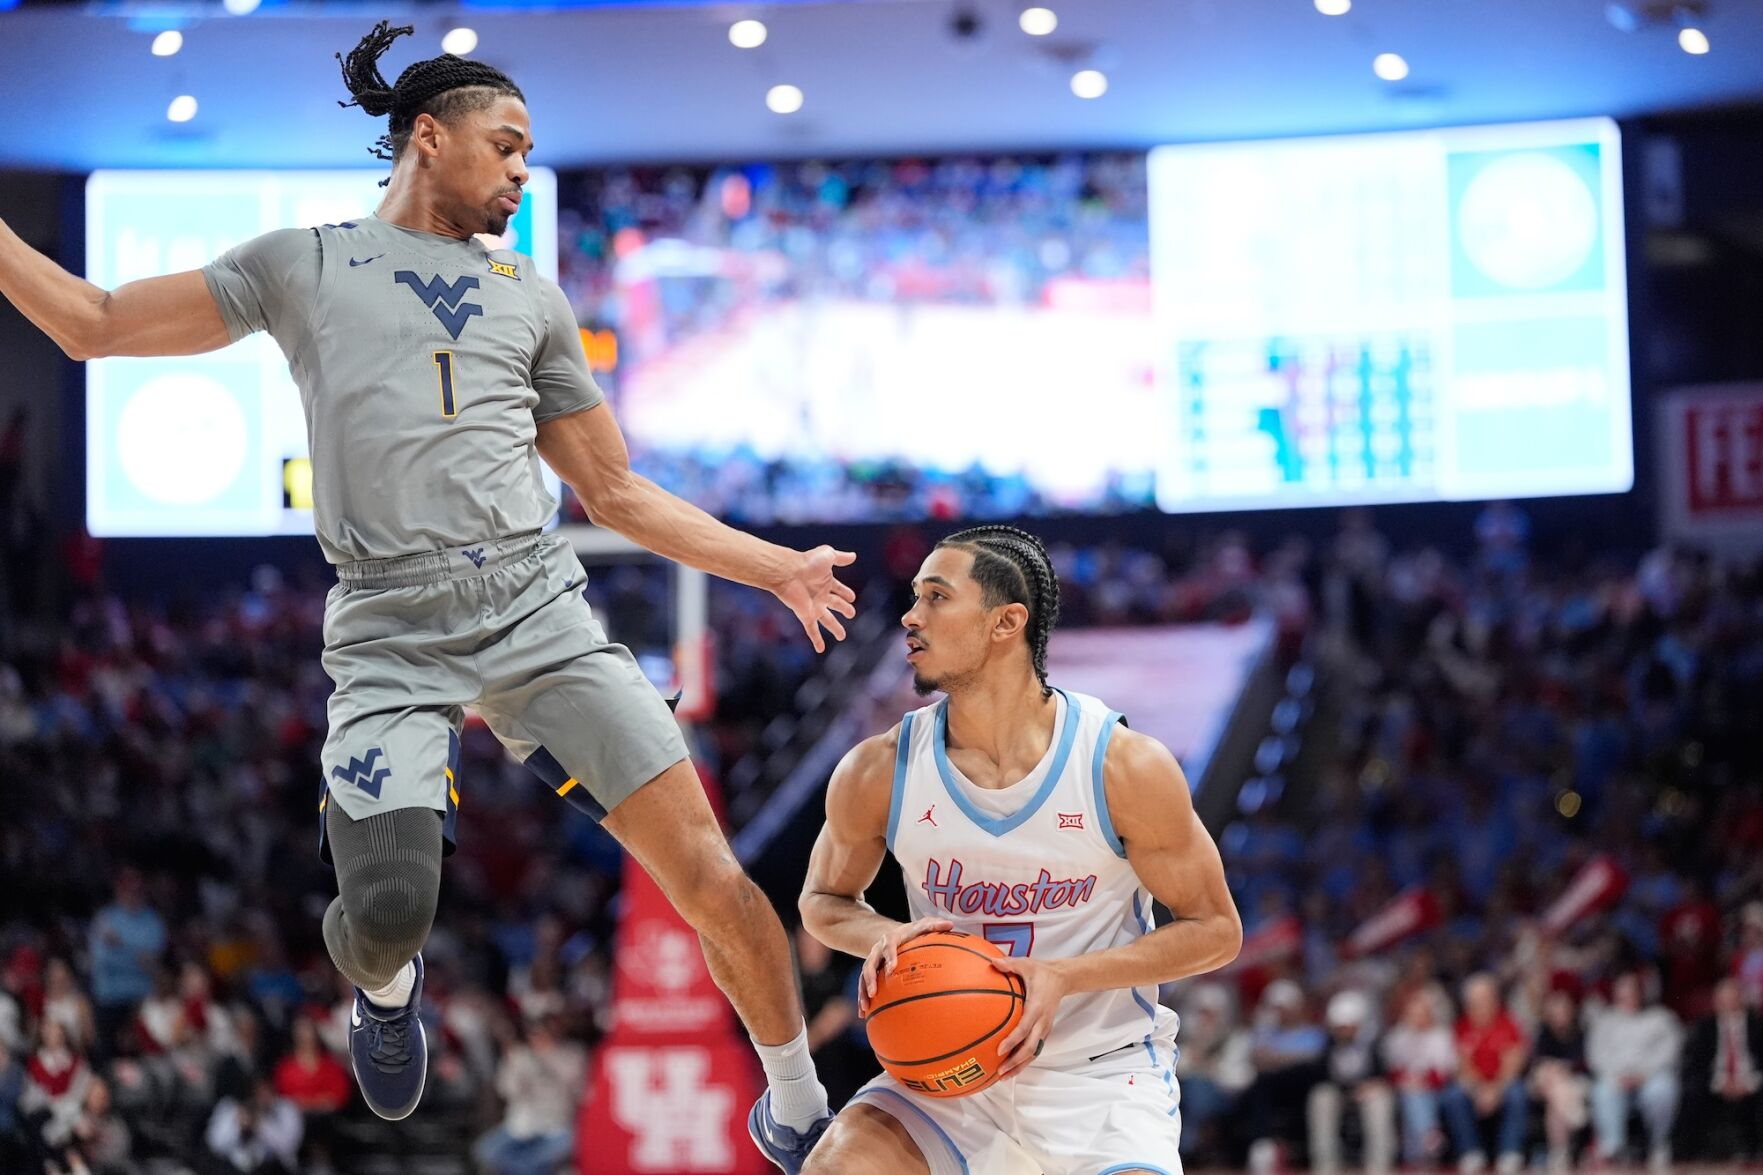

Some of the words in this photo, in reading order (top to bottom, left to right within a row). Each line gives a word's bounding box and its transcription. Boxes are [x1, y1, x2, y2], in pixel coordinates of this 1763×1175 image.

[432, 350, 457, 418] 1
[921, 857, 1098, 917] Houston
[900, 1062, 986, 1093] ELITE
